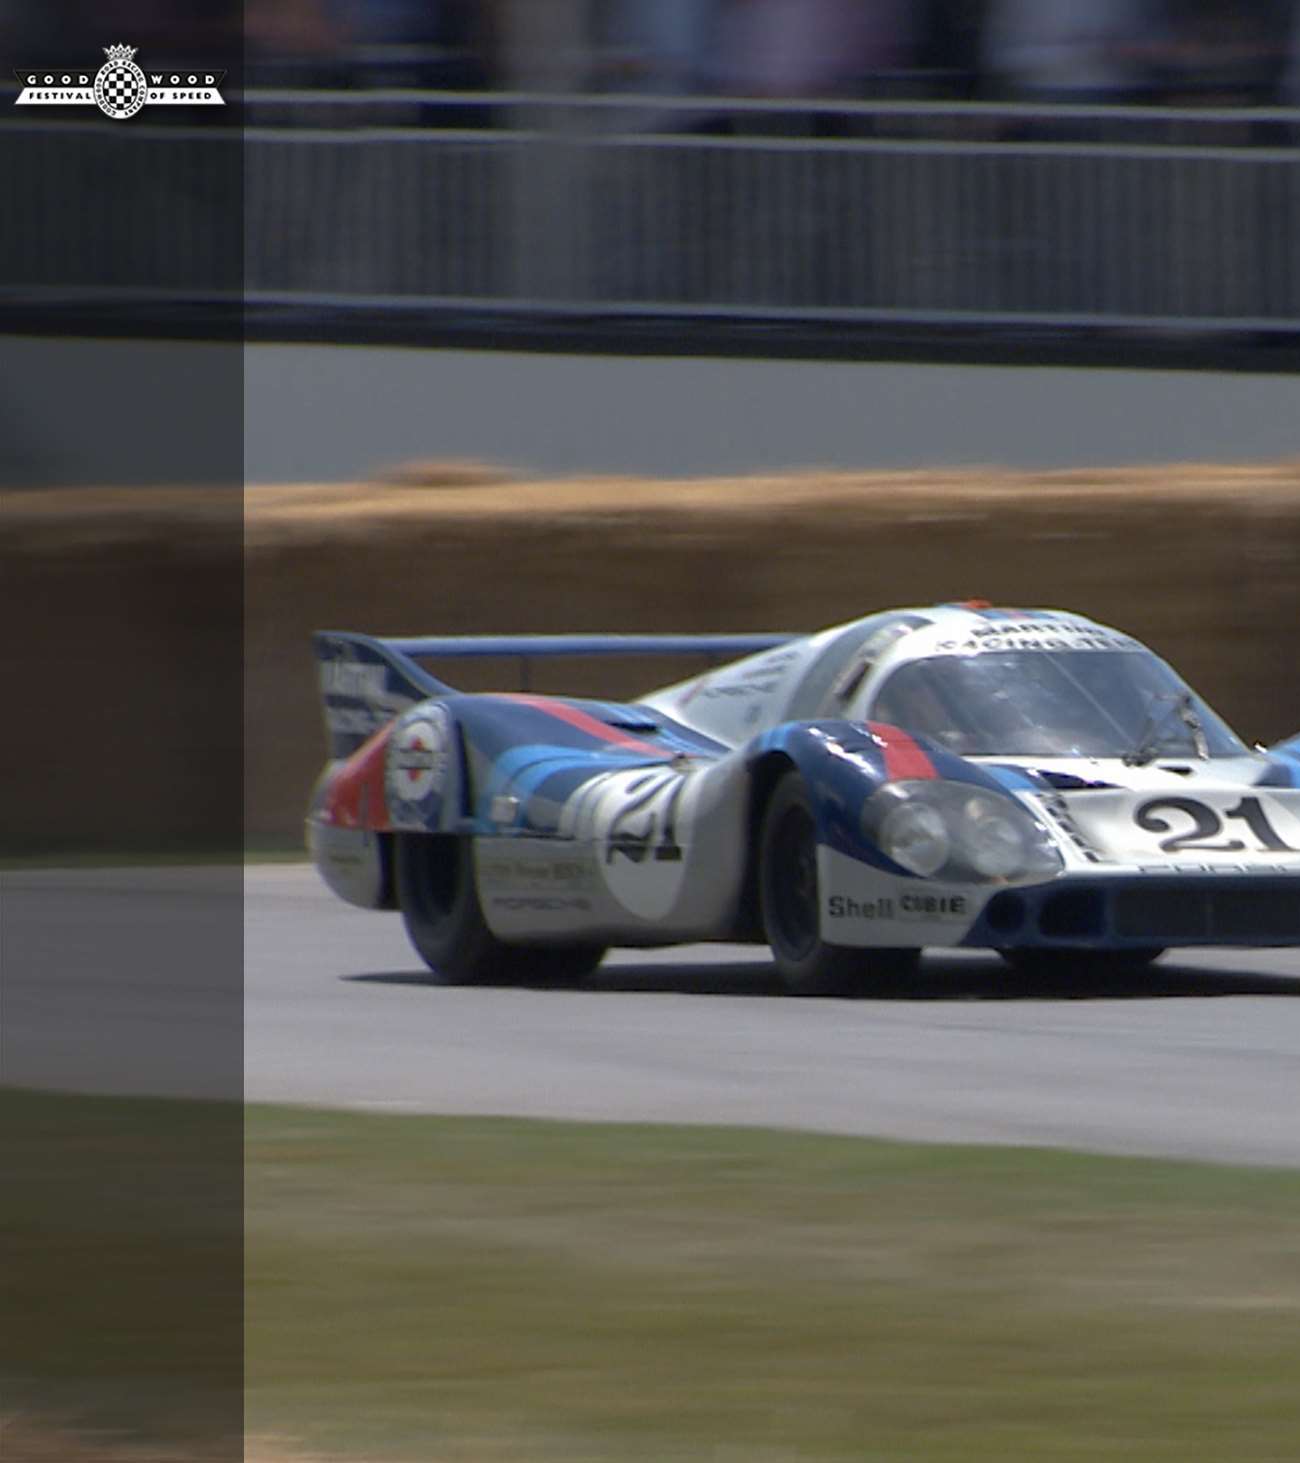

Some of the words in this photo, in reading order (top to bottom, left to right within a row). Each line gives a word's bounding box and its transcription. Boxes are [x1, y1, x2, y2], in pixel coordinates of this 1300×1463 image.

[606, 773, 683, 866] 21
[829, 896, 893, 918] Shell
[900, 895, 966, 913] CIBIE
